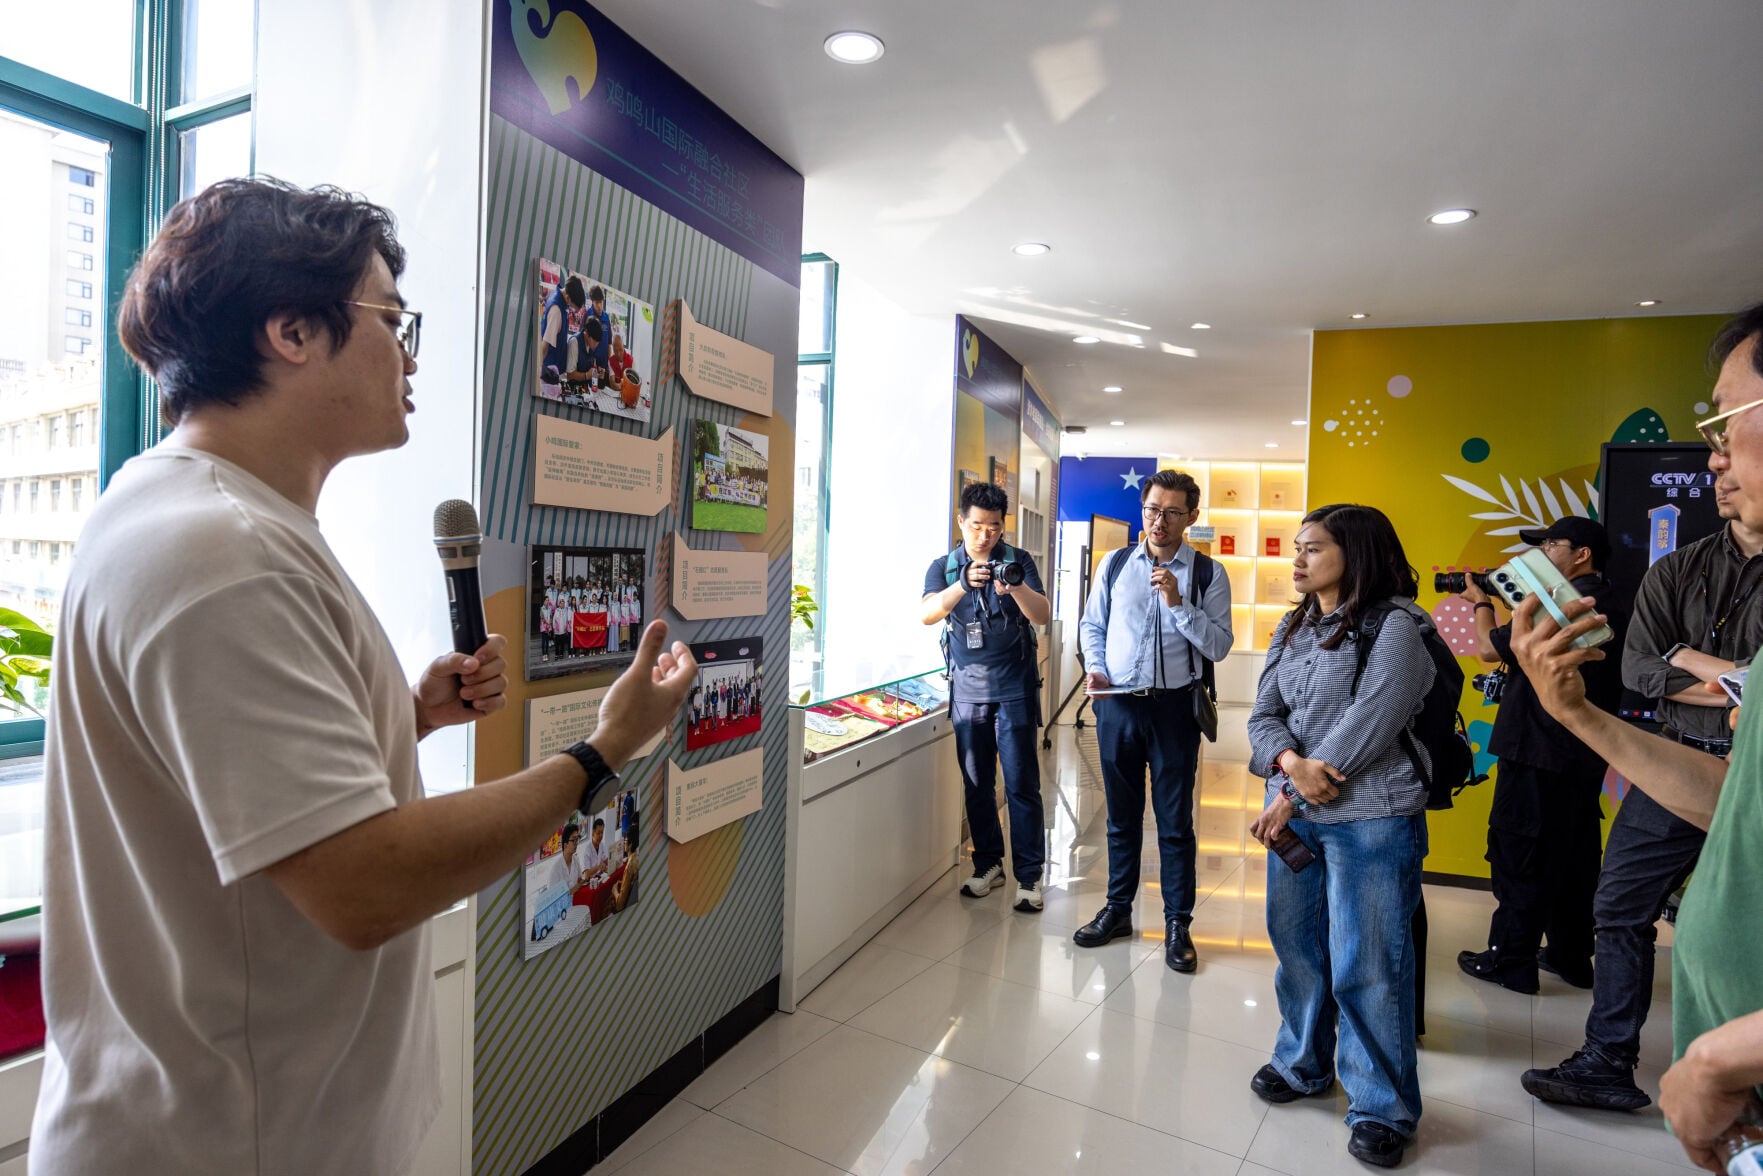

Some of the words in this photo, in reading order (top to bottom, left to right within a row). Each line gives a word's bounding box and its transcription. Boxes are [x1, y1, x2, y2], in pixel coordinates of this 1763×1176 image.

[606, 78, 751, 200] 鸡鸣山国际融合社区
[1651, 473, 1697, 485] CCTV
[1705, 474, 1711, 485] 1
[1666, 488, 1701, 497] 综合
